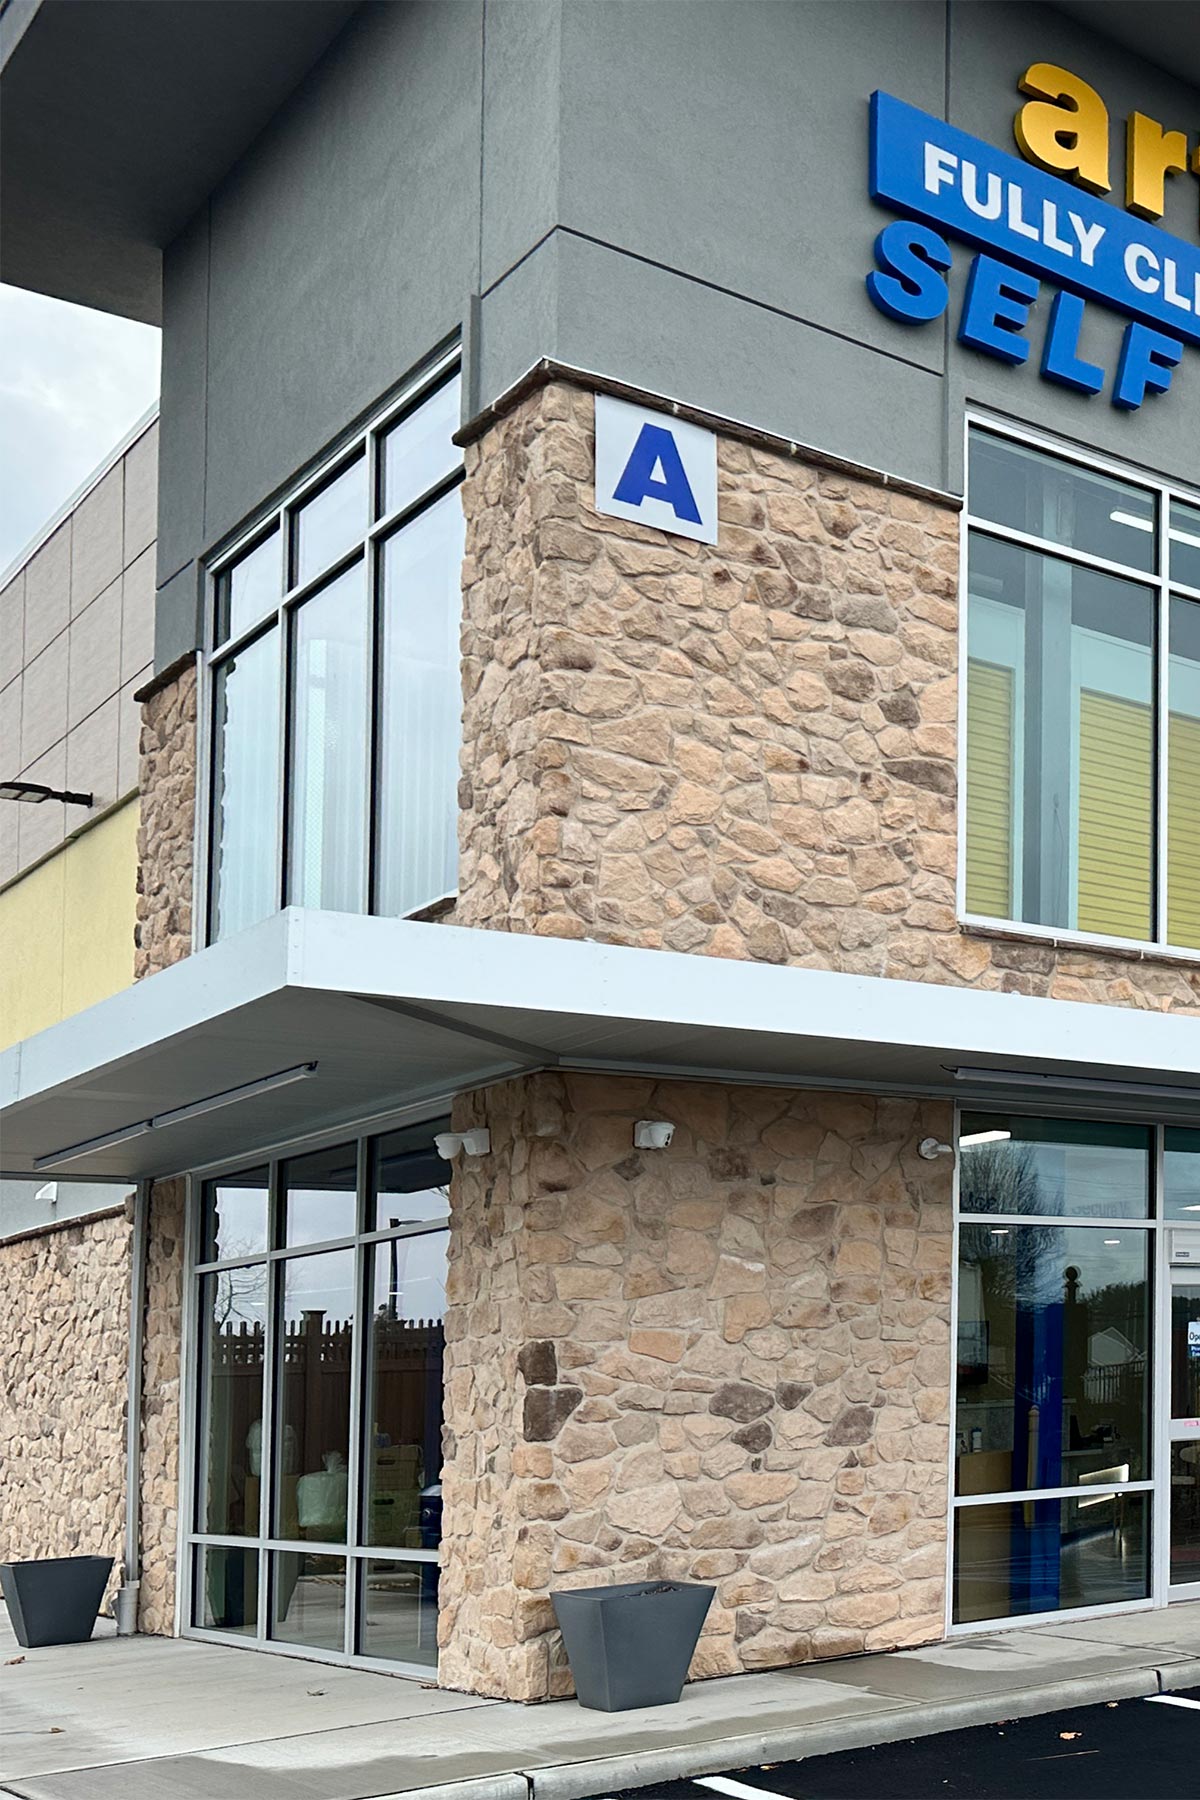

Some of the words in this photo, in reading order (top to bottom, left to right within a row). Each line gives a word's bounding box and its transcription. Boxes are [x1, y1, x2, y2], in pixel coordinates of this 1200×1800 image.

[923, 141, 1106, 267] FULLY
[866, 220, 1183, 411] SELF
[612, 422, 703, 526] A
